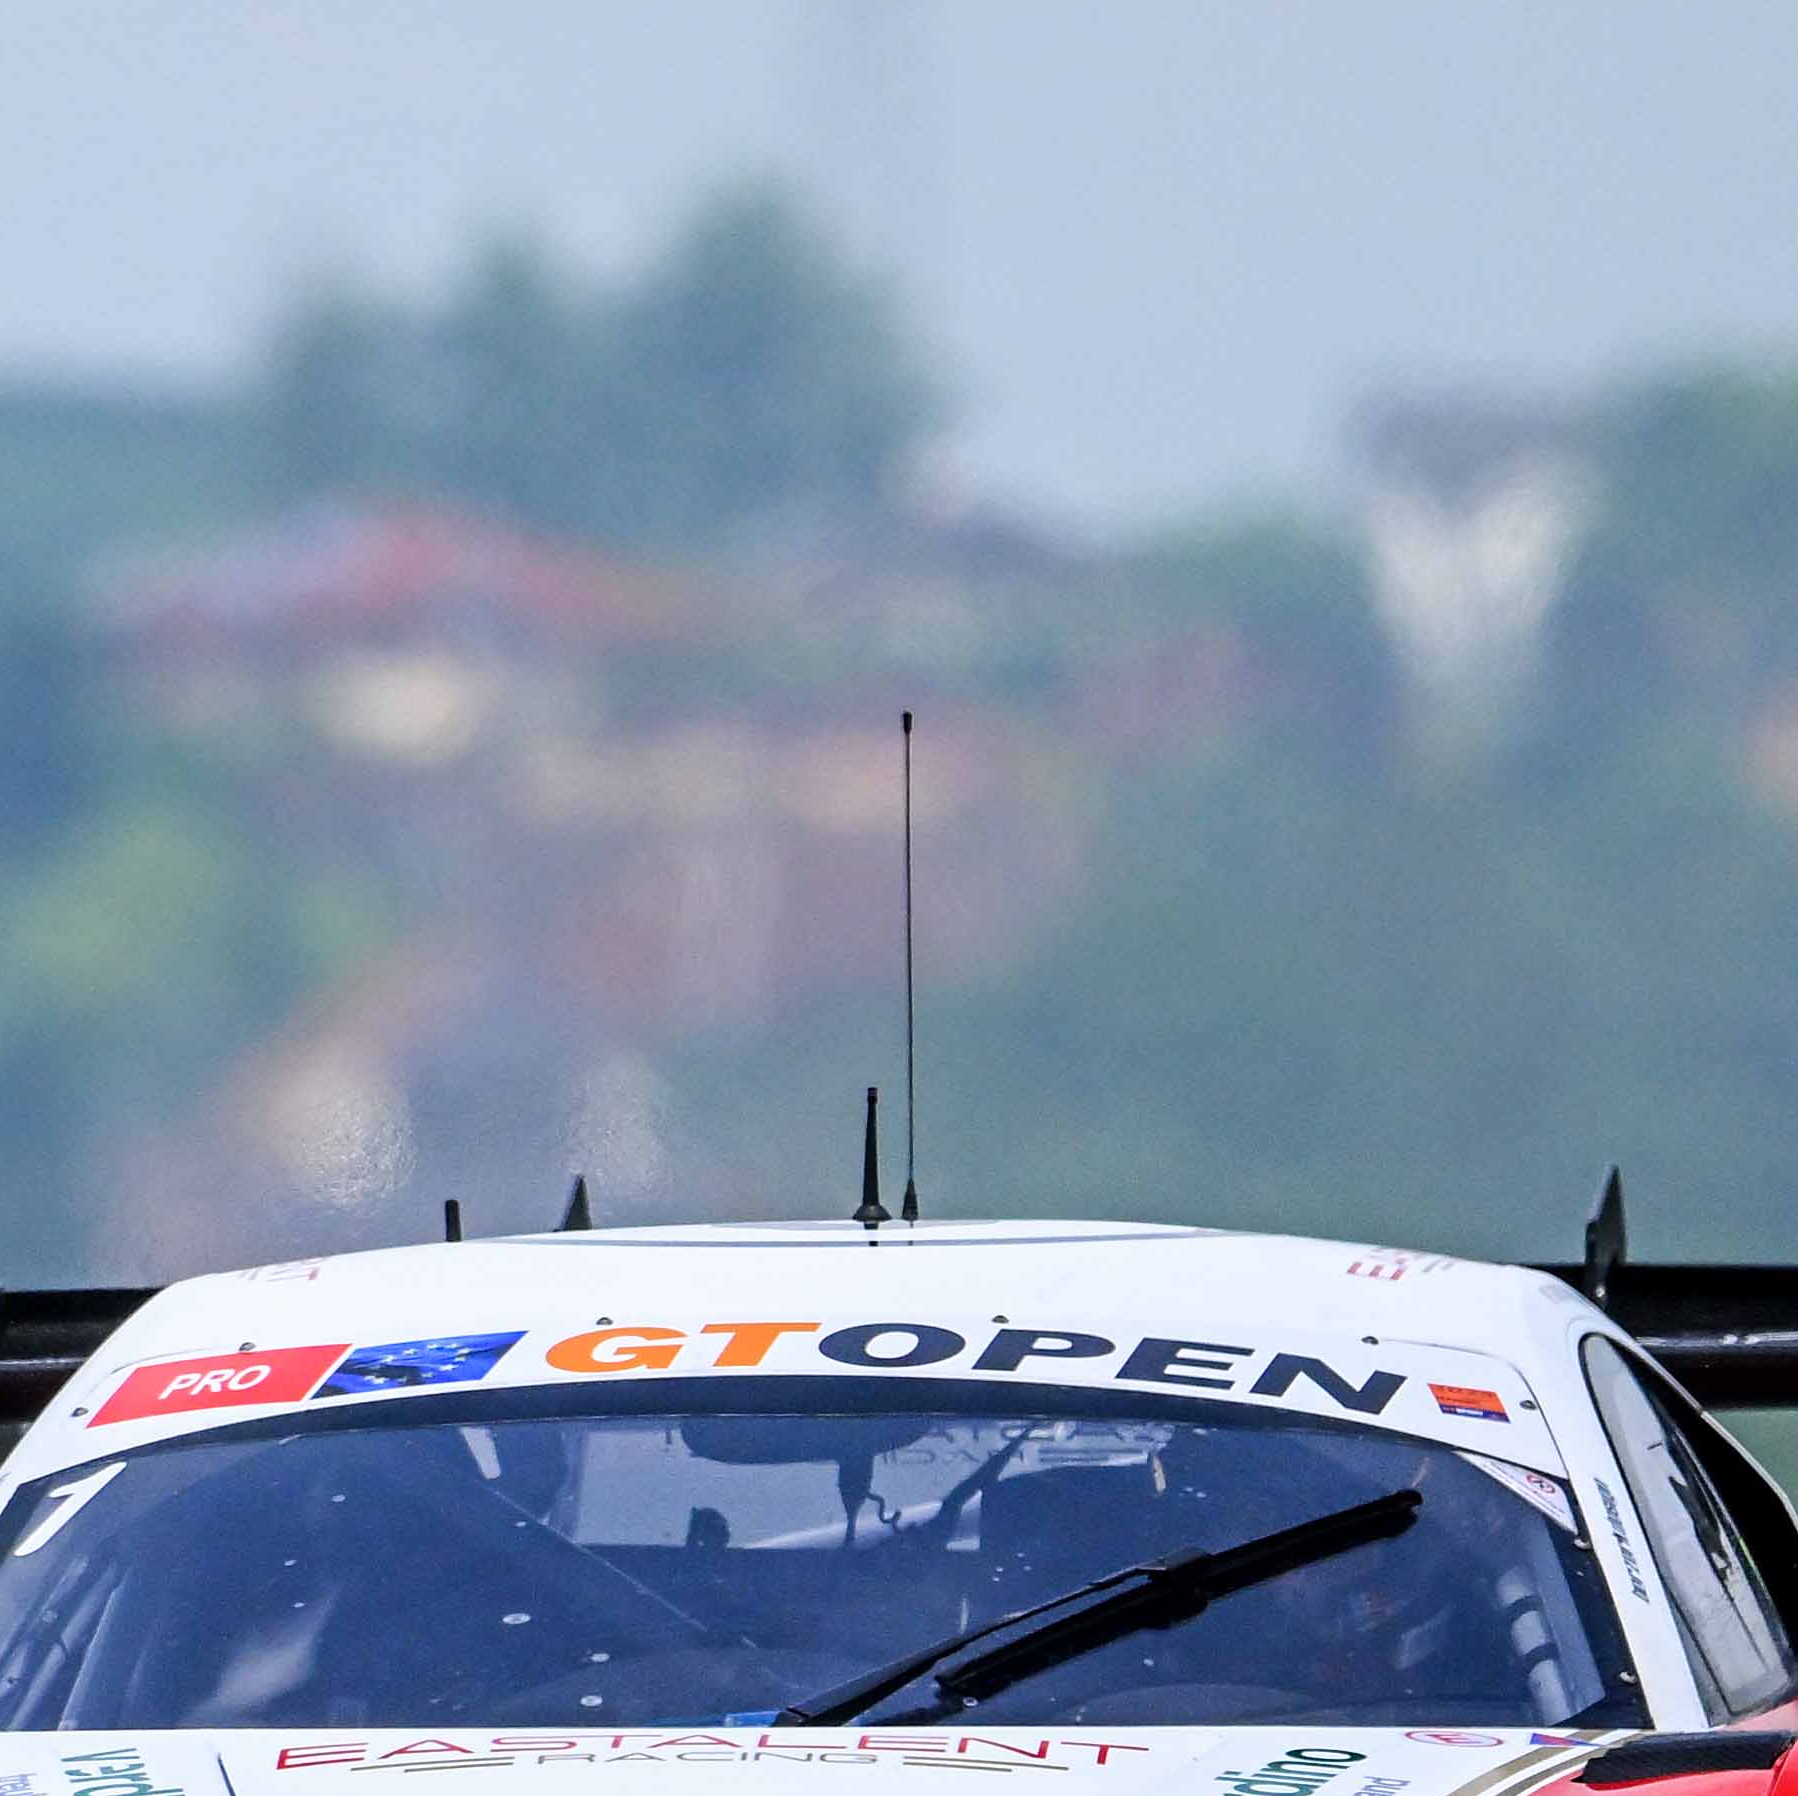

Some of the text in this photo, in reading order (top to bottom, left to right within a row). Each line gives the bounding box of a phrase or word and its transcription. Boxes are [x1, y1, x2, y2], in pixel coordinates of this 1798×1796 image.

[158, 1364, 272, 1401] PRO
[12, 1461, 128, 1557] 1
[276, 1734, 1149, 1770] EASTALENT
[537, 1751, 879, 1765] RACING
